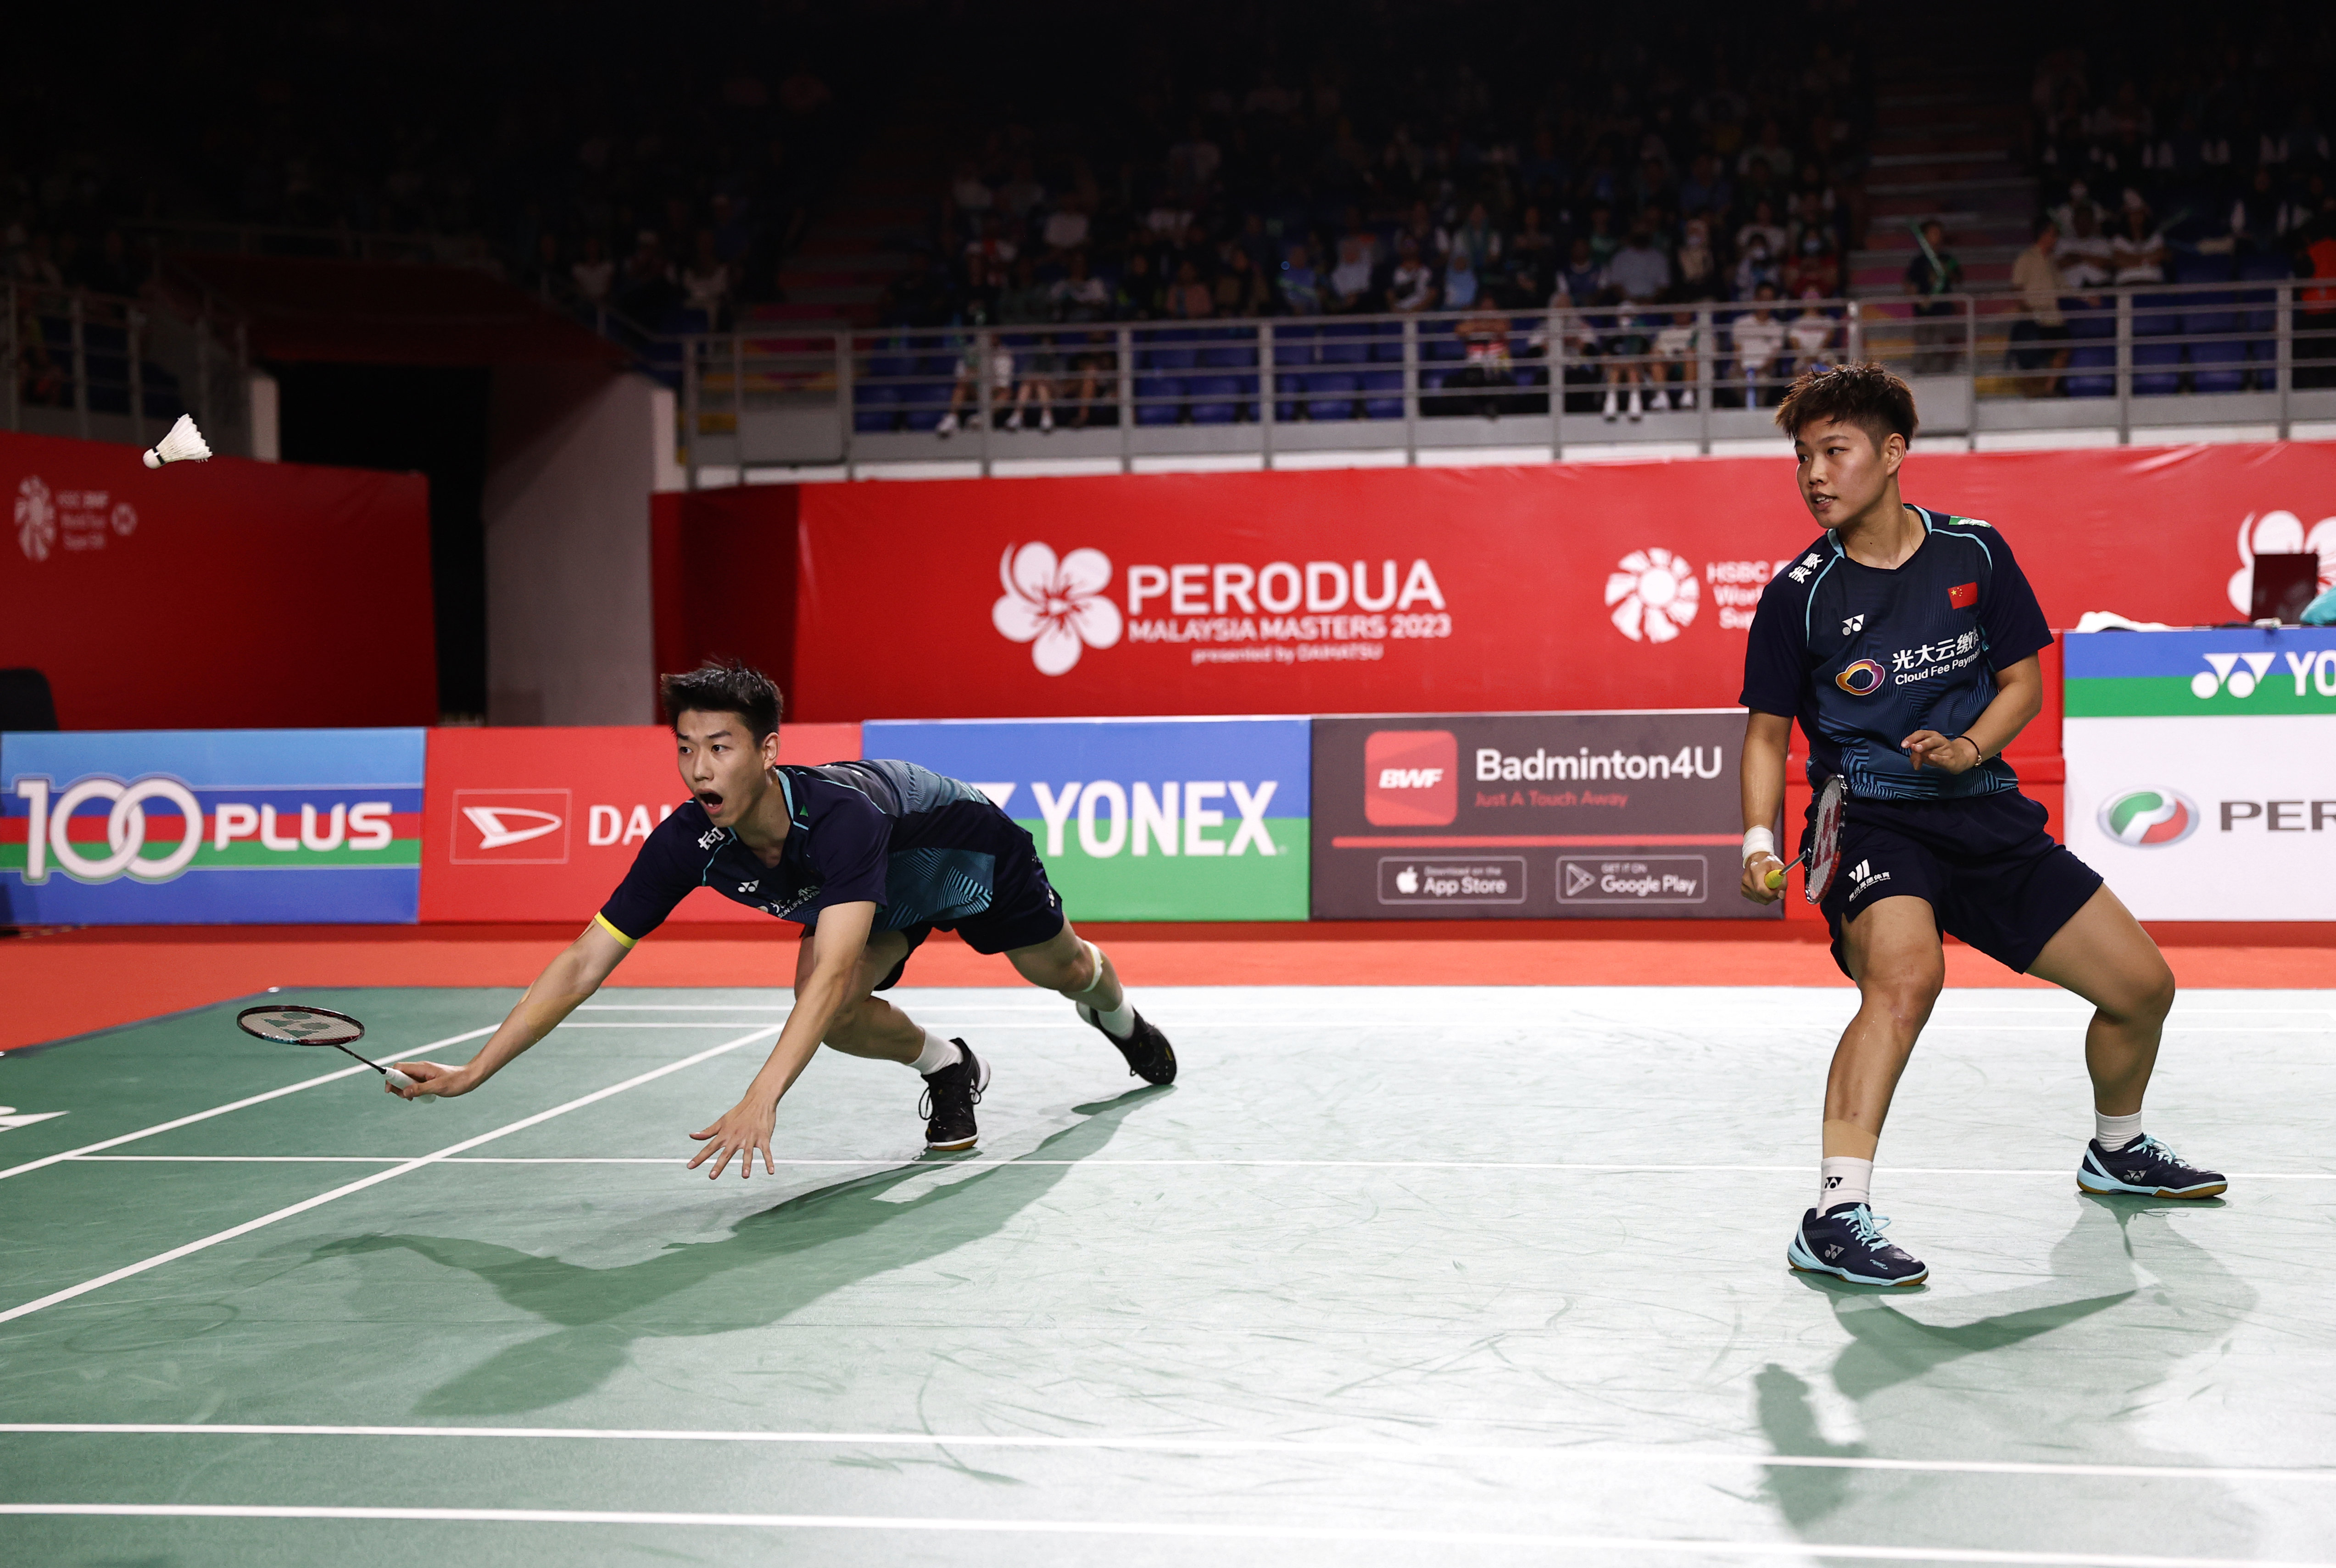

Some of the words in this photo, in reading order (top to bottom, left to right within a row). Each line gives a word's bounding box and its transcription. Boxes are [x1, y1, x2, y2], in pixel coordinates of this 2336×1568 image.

[1706, 561, 1770, 584] HSBC
[1127, 558, 1446, 615] PERODUA
[1713, 584, 1764, 606] Worl
[1128, 617, 1257, 642] MALAYSIA
[1259, 615, 1388, 641] MASTERS
[1390, 613, 1452, 638] 2023
[1191, 645, 1272, 666] presented
[1274, 644, 1295, 665] by
[1895, 668, 1928, 685] Cloud
[1931, 664, 1950, 677] Fee
[2284, 649, 2336, 697] YO
[1476, 746, 1723, 781] Badminton4U
[1378, 768, 1444, 789] BWF
[1475, 791, 1507, 807] Just
[1510, 790, 1525, 806] A
[1528, 790, 1578, 806] Touch
[1580, 790, 1629, 809] Away
[1031, 779, 1279, 858] YONEX
[2220, 800, 2336, 831] PER
[17, 778, 204, 880] 100
[214, 802, 393, 851] PLUS
[1423, 877, 1460, 897] App
[1461, 877, 1507, 894] Store
[1600, 874, 1661, 897] Google
[1662, 874, 1697, 896] Play
[778, 908, 791, 918] SUN
[789, 899, 803, 911] LIFE
